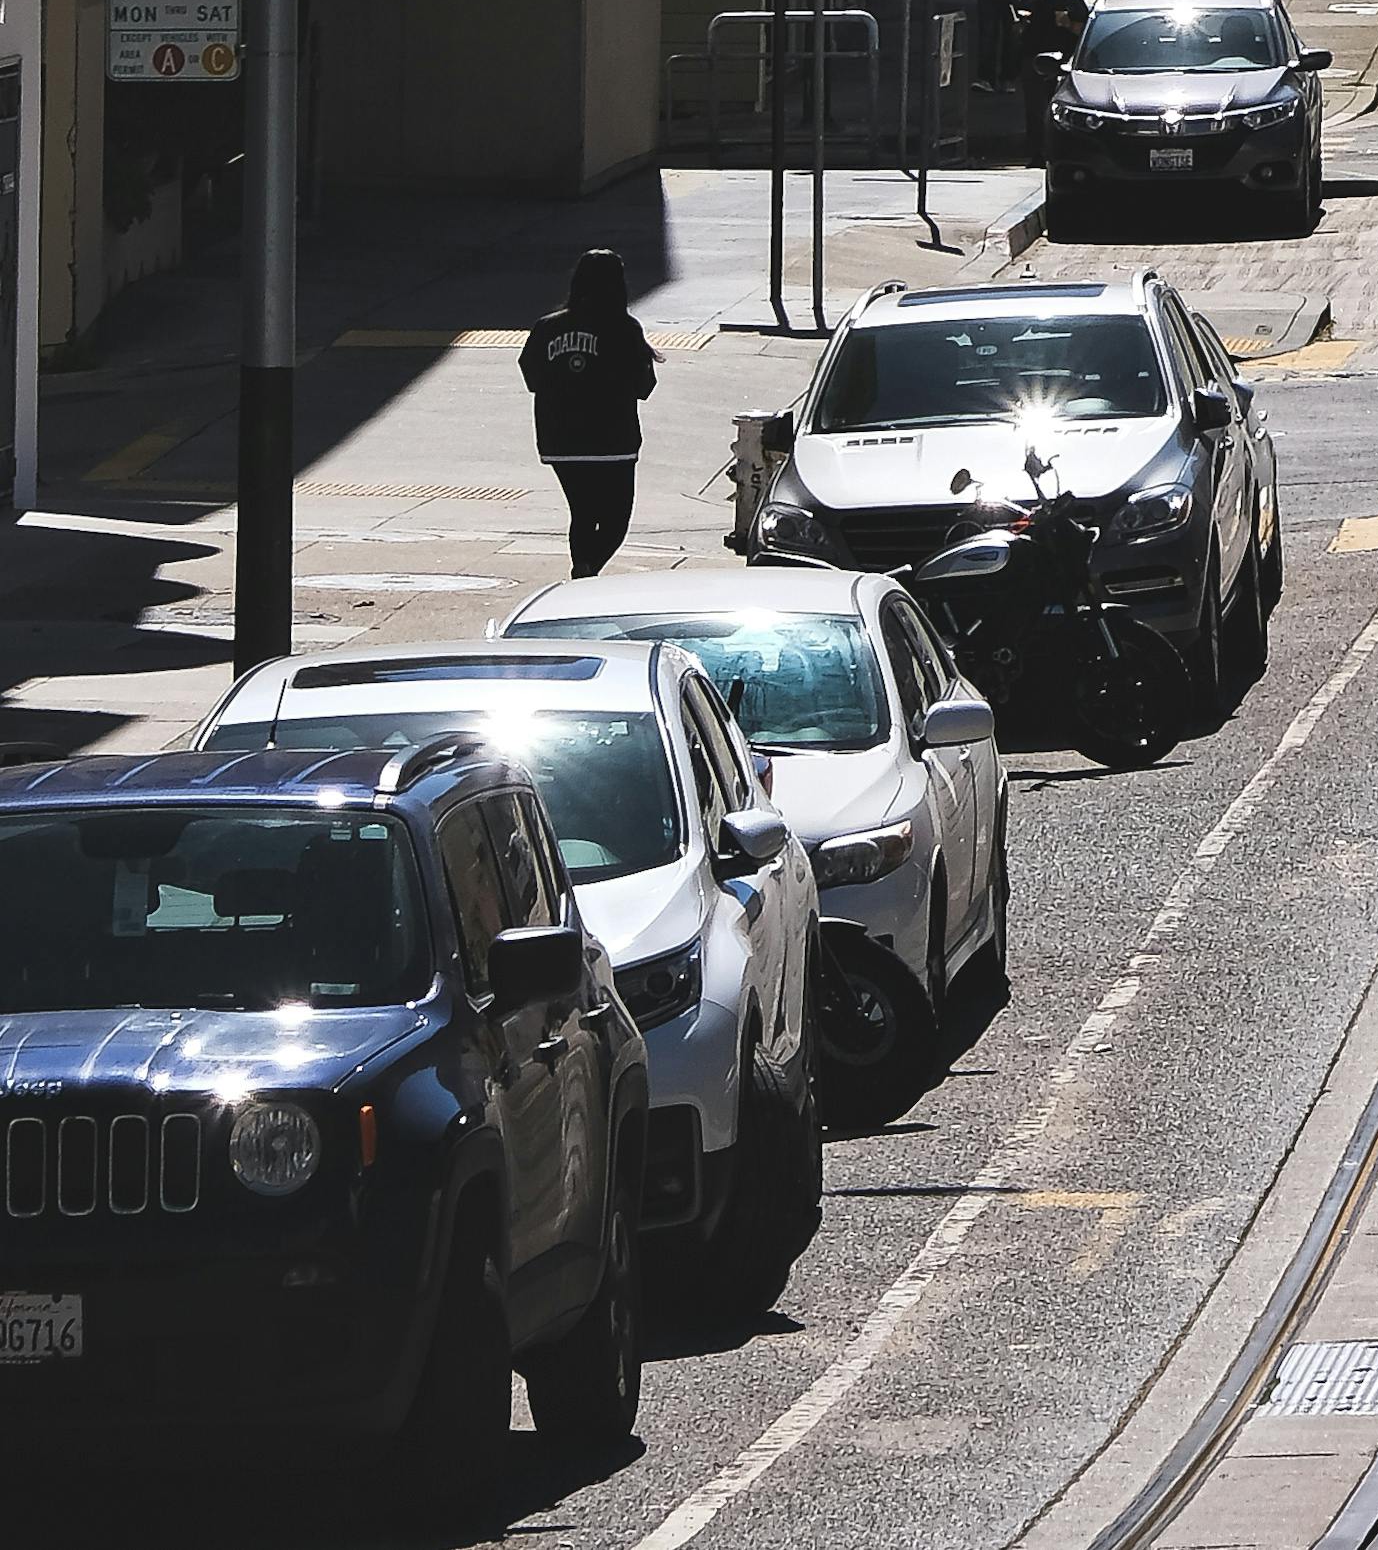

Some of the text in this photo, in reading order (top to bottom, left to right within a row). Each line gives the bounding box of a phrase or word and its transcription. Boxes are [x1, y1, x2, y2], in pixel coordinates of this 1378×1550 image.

[114, 6, 157, 22] MON
[197, 5, 232, 22] SAT
[120, 33, 152, 43] EXCEPT
[160, 33, 199, 43] VEHICLES
[161, 48, 176, 73] A
[212, 47, 225, 72] C
